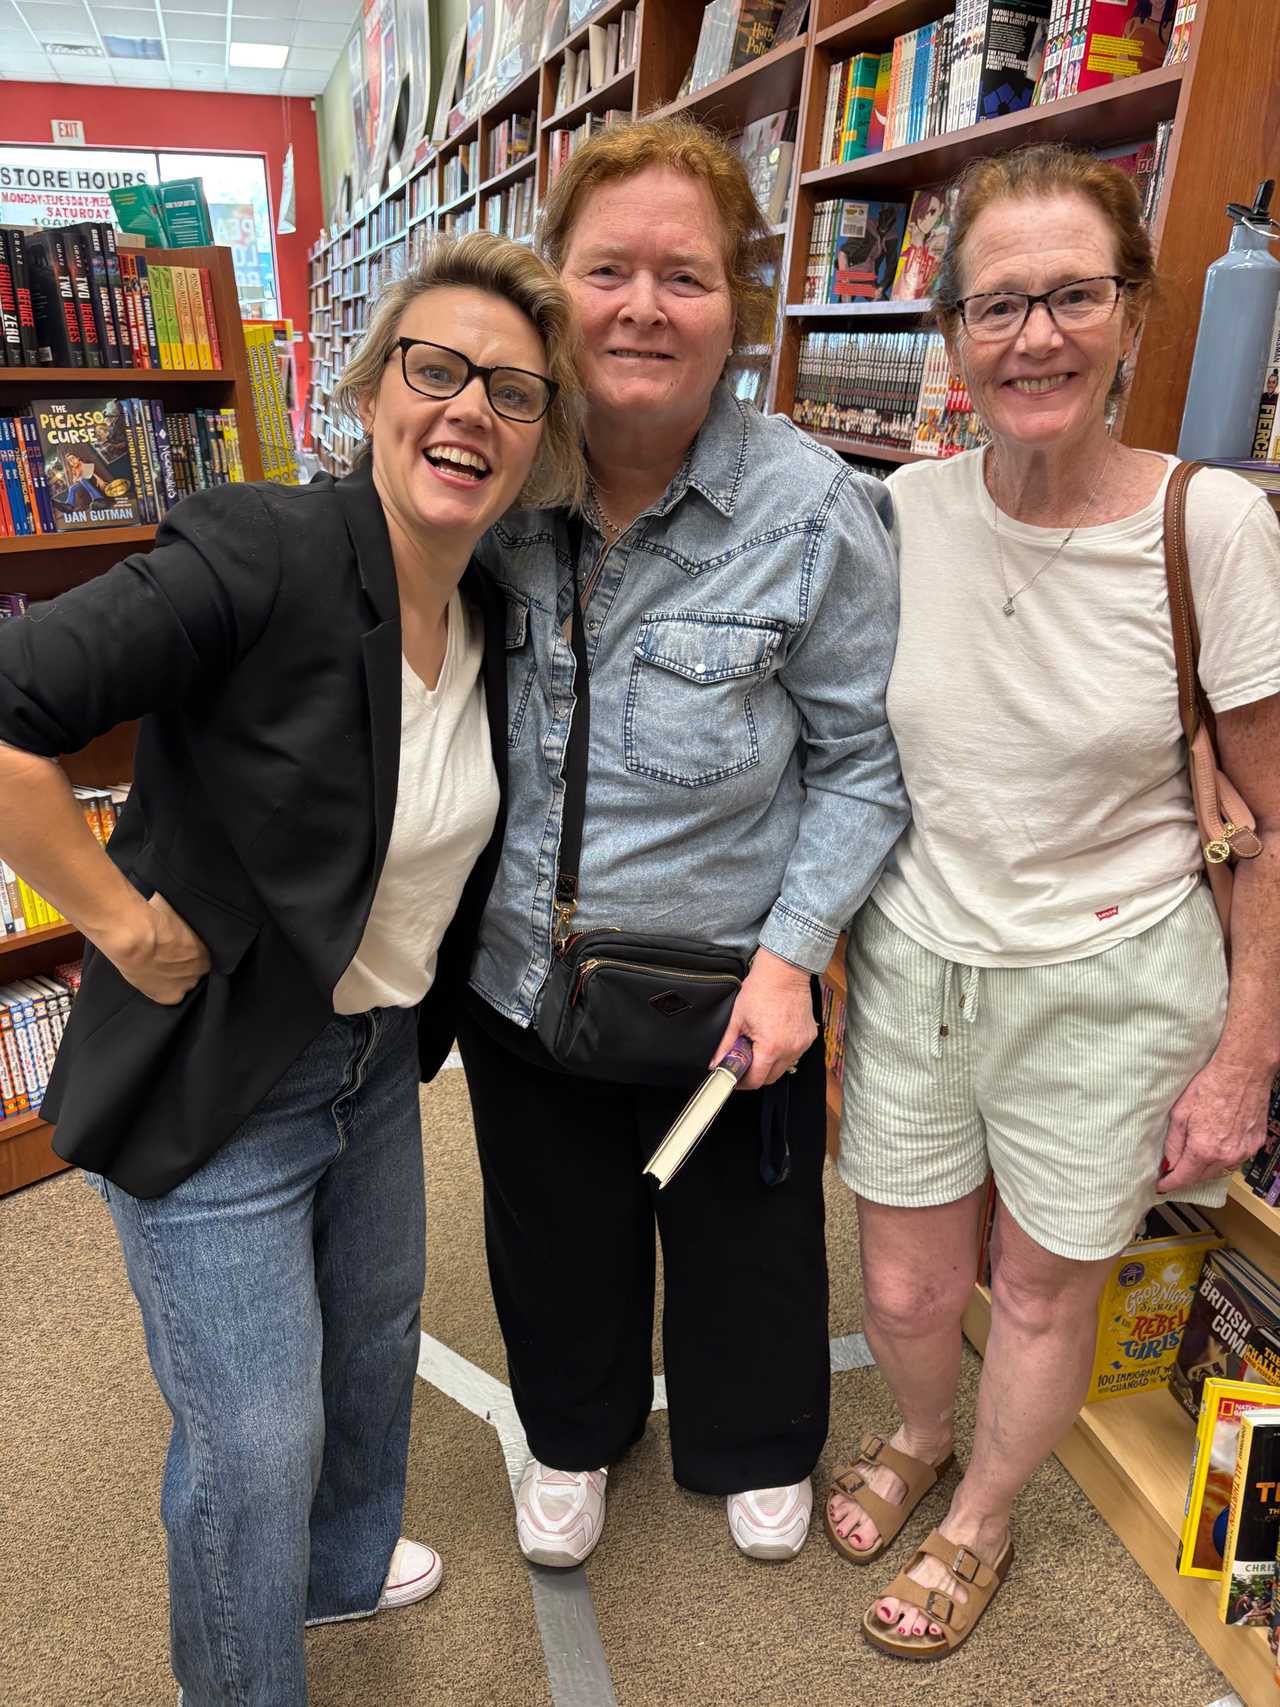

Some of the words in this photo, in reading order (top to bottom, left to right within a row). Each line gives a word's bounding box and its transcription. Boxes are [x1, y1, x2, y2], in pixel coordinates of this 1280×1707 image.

[752, 22, 774, 41] Harry
[57, 122, 79, 138] EXIT
[0, 167, 70, 188] STORE
[77, 171, 146, 189] HOURS
[47, 207, 110, 219] SATURDAY
[58, 275, 73, 298] TWO
[75, 277, 90, 299] TWO
[16, 287, 35, 328] REFUGEE
[143, 298, 154, 328] FOOTBALL
[4, 313, 20, 344] ZERO
[63, 301, 81, 344] DEGREES
[80, 303, 98, 344] DEGREES
[51, 405, 67, 413] THE
[47, 428, 98, 444] CURSE
[1253, 404, 1276, 458] FIERCE
[125, 429, 138, 466] HOUDINI
[136, 426, 147, 463] HOUDINI
[142, 464, 151, 483] AND
[64, 511, 87, 523] DAN
[90, 508, 133, 522] GUTMAN
[1202, 1264, 1217, 1283] THE
[1200, 1280, 1252, 1338] BRITISH
[1131, 1309, 1186, 1342] REBEL
[1117, 1331, 1180, 1361] GIRLS
[1097, 1374, 1115, 1388] 100
[1115, 1366, 1161, 1384] IMMIGRANT
